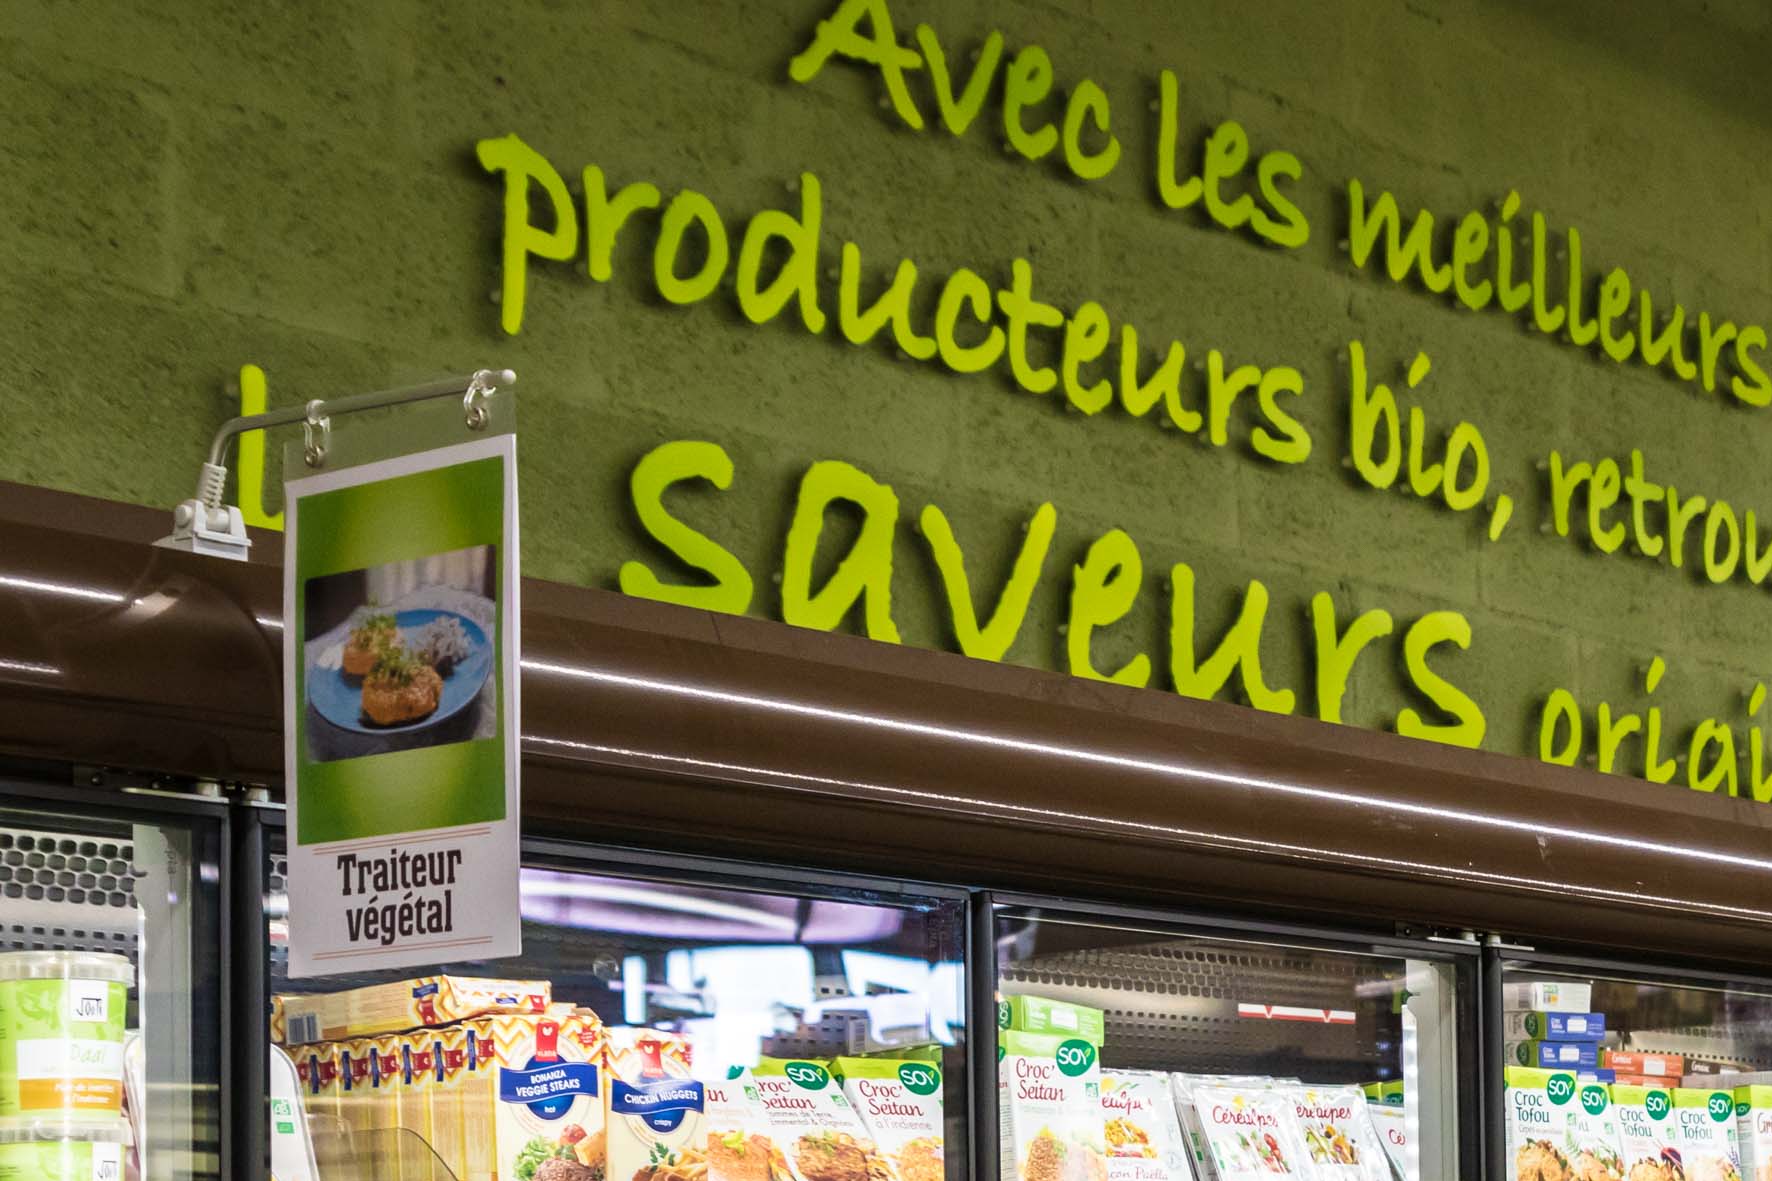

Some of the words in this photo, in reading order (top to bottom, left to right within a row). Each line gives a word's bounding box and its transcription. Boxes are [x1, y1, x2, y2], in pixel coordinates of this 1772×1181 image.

[790, 0, 1121, 180] Avec
[1160, 70, 1310, 248] les
[477, 133, 1312, 464] producteurs
[1350, 341, 1514, 542] bio,
[619, 440, 1487, 750] saveurs
[337, 848, 462, 896] Traiteur
[346, 890, 453, 946] végétal
[1058, 1047, 1090, 1066] SOY
[531, 1070, 566, 1083] BONANZA
[787, 1069, 822, 1082] SOY
[1016, 1058, 1055, 1080] Croc'
[901, 1071, 933, 1085] SOY
[516, 1084, 548, 1097] VEGGIE
[550, 1079, 580, 1093] STEAKS
[660, 1090, 697, 1102] NUGGETS
[859, 1081, 902, 1098] Croc'
[1017, 1079, 1065, 1101] Seitan
[1549, 1080, 1574, 1098] SOY
[869, 1099, 923, 1116] Seitan
[1515, 1091, 1543, 1107] Croc
[1582, 1092, 1606, 1107] SOY
[1646, 1097, 1671, 1113] SOY
[1709, 1099, 1733, 1115] SOY
[1515, 1106, 1550, 1125] Tofou
[1619, 1108, 1644, 1122] Croc
[1680, 1110, 1706, 1125] Croc
[1622, 1122, 1652, 1139] Tofou
[1681, 1123, 1712, 1140] Tofou
